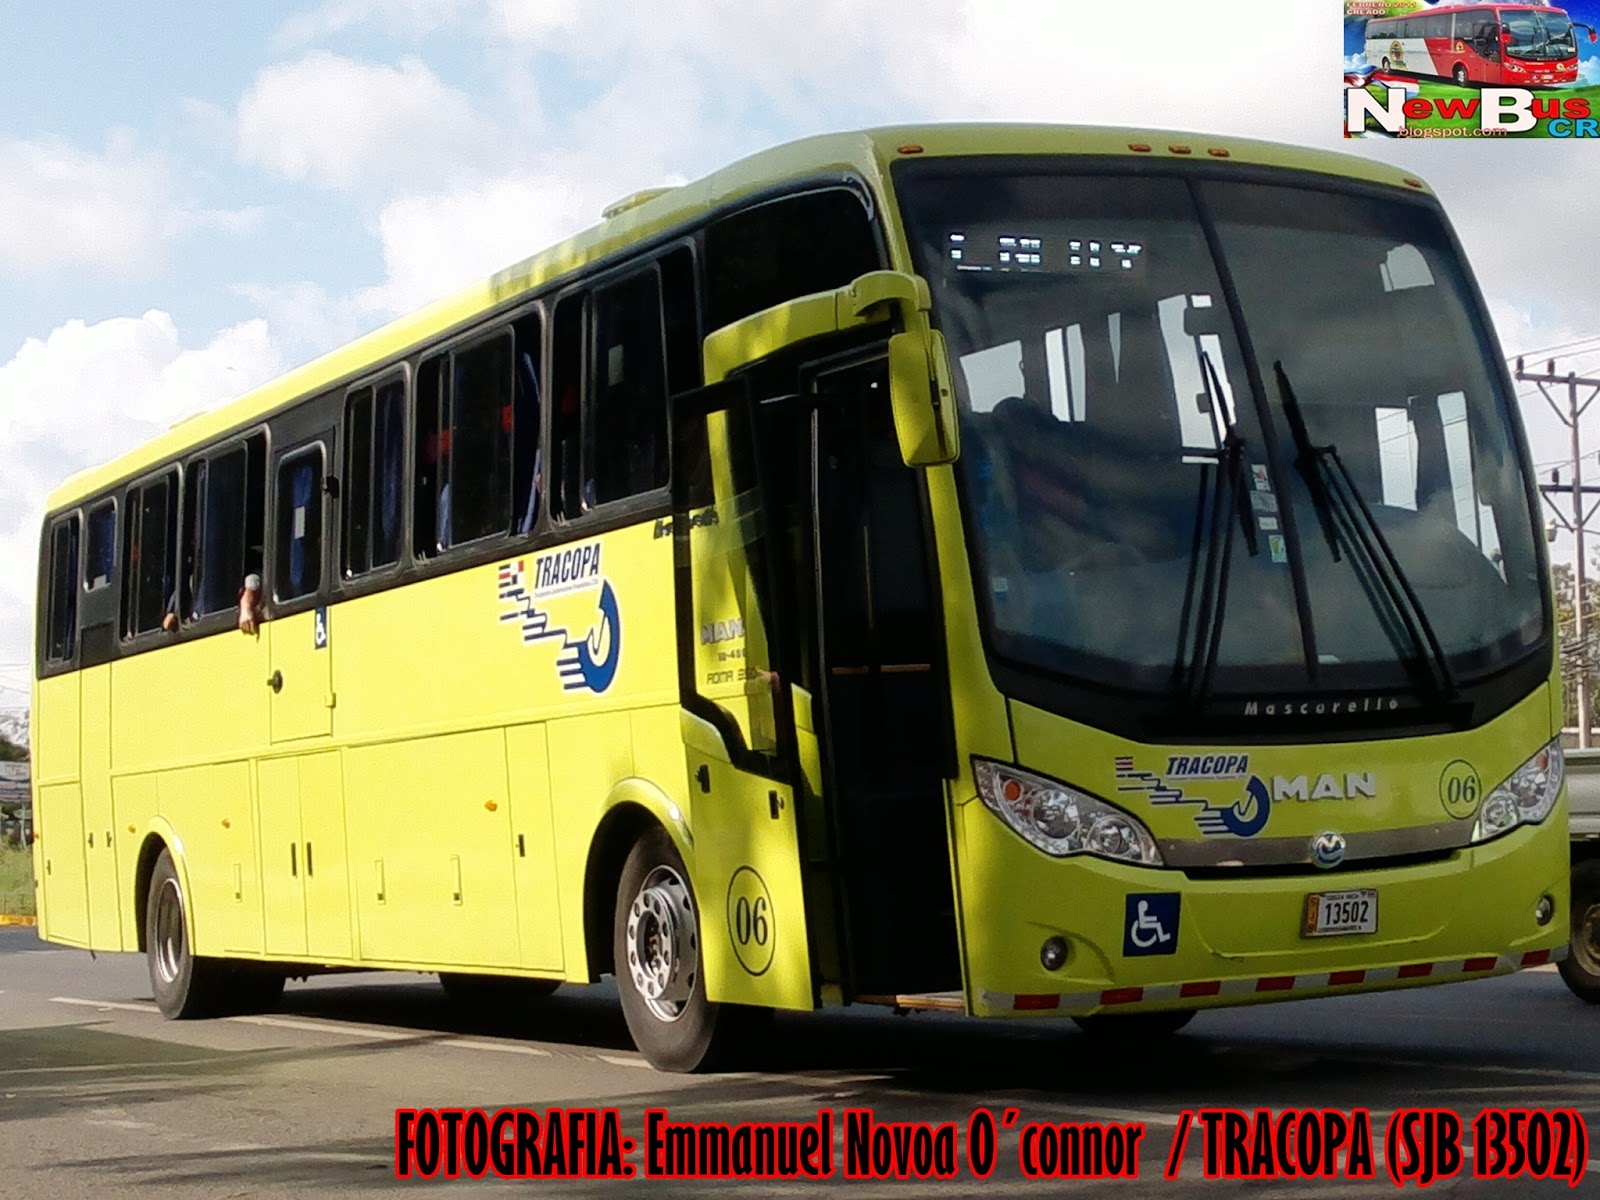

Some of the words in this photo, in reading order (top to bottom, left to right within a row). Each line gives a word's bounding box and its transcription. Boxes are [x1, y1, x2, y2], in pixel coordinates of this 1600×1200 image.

[534, 543, 601, 589] TRACOPA
[701, 618, 746, 645] MAN
[1244, 698, 1399, 716] Mascarello
[1166, 755, 1249, 776] TRACOPA
[1271, 771, 1377, 802] MAN
[1447, 775, 1476, 804] 06
[736, 896, 768, 946] 06
[1325, 900, 1369, 926] 13502
